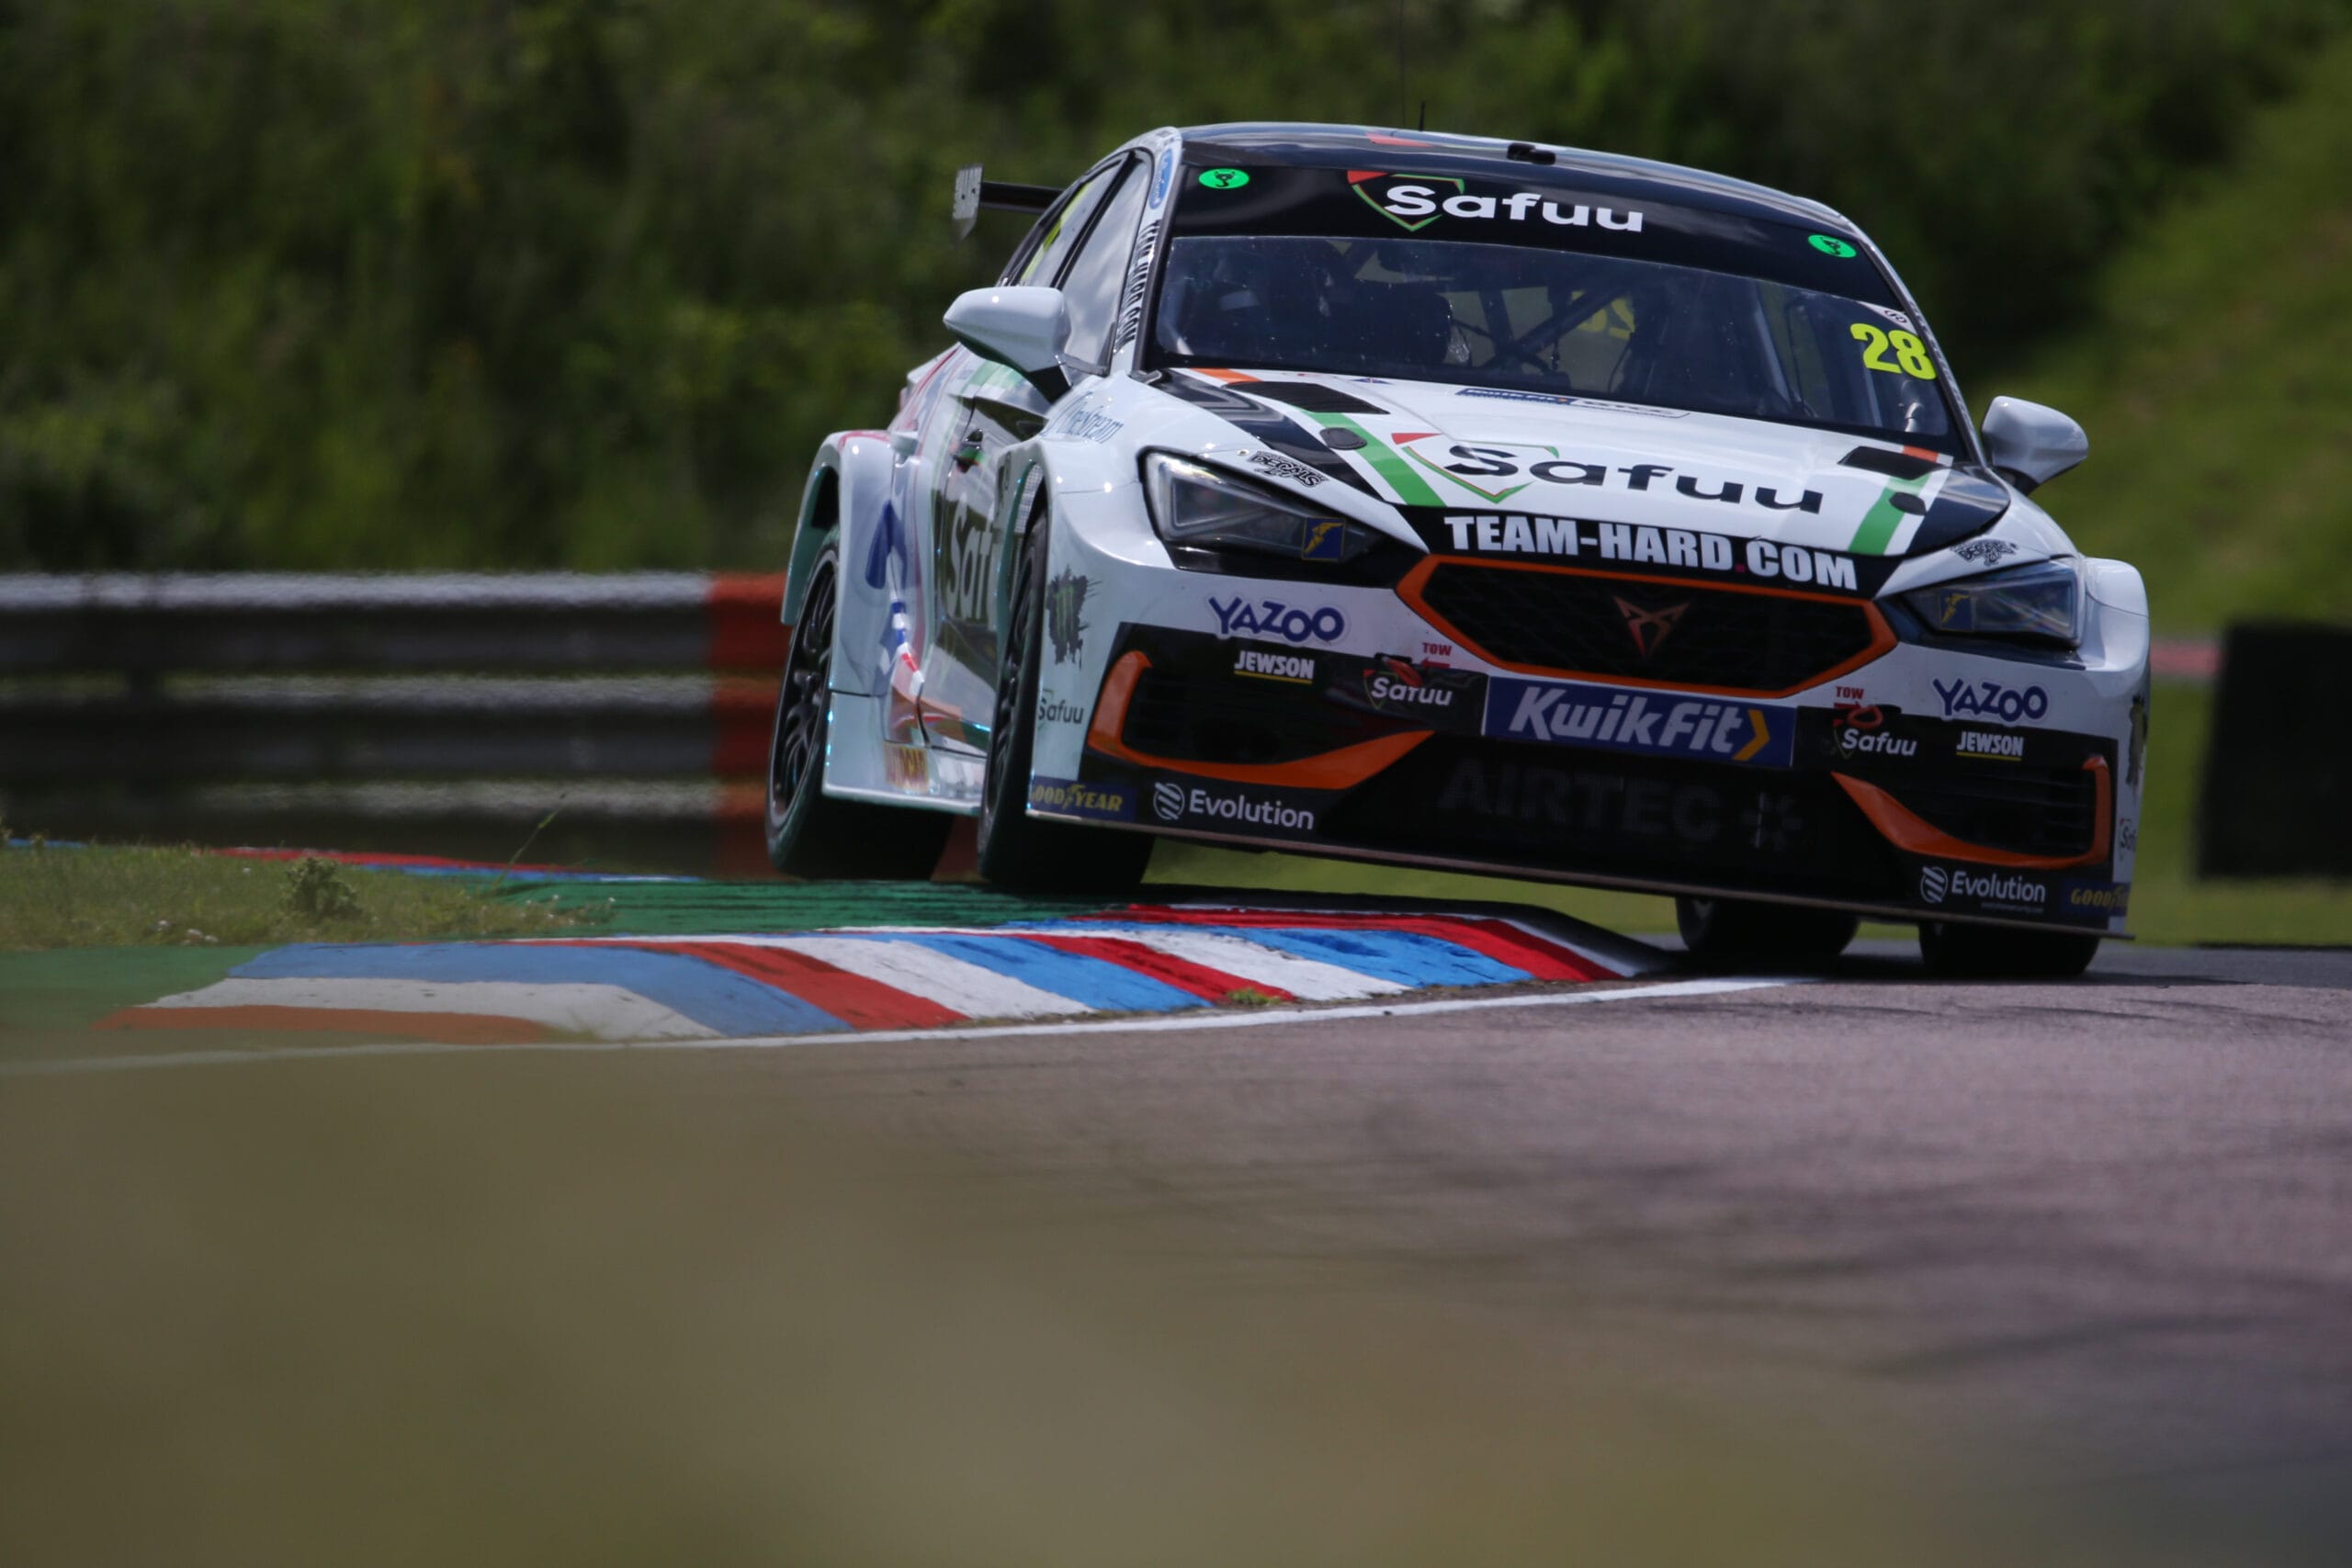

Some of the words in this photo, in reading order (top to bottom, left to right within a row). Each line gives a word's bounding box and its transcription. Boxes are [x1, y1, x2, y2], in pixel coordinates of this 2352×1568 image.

[1384, 185, 1644, 232] Safuu
[1849, 322, 1938, 380] 28
[1443, 445, 1824, 514] Safuu
[1443, 515, 1858, 591] TEAM-HARD.COM
[1208, 596, 1345, 642] YAZOO
[1234, 649, 1315, 681] JEWSON
[1422, 642, 1452, 657] TOW
[1372, 676, 1453, 706] Safuu
[1836, 685, 1864, 700] TOW
[1933, 678, 2049, 722] YAZOO
[1038, 698, 1084, 724] Safuu
[1841, 728, 1917, 757] Safuu
[1956, 731, 2025, 756] JEWSON
[1190, 789, 1314, 829] Evolution
[1436, 757, 1723, 843] AIRTEC
[1951, 870, 2046, 903] Evolution
